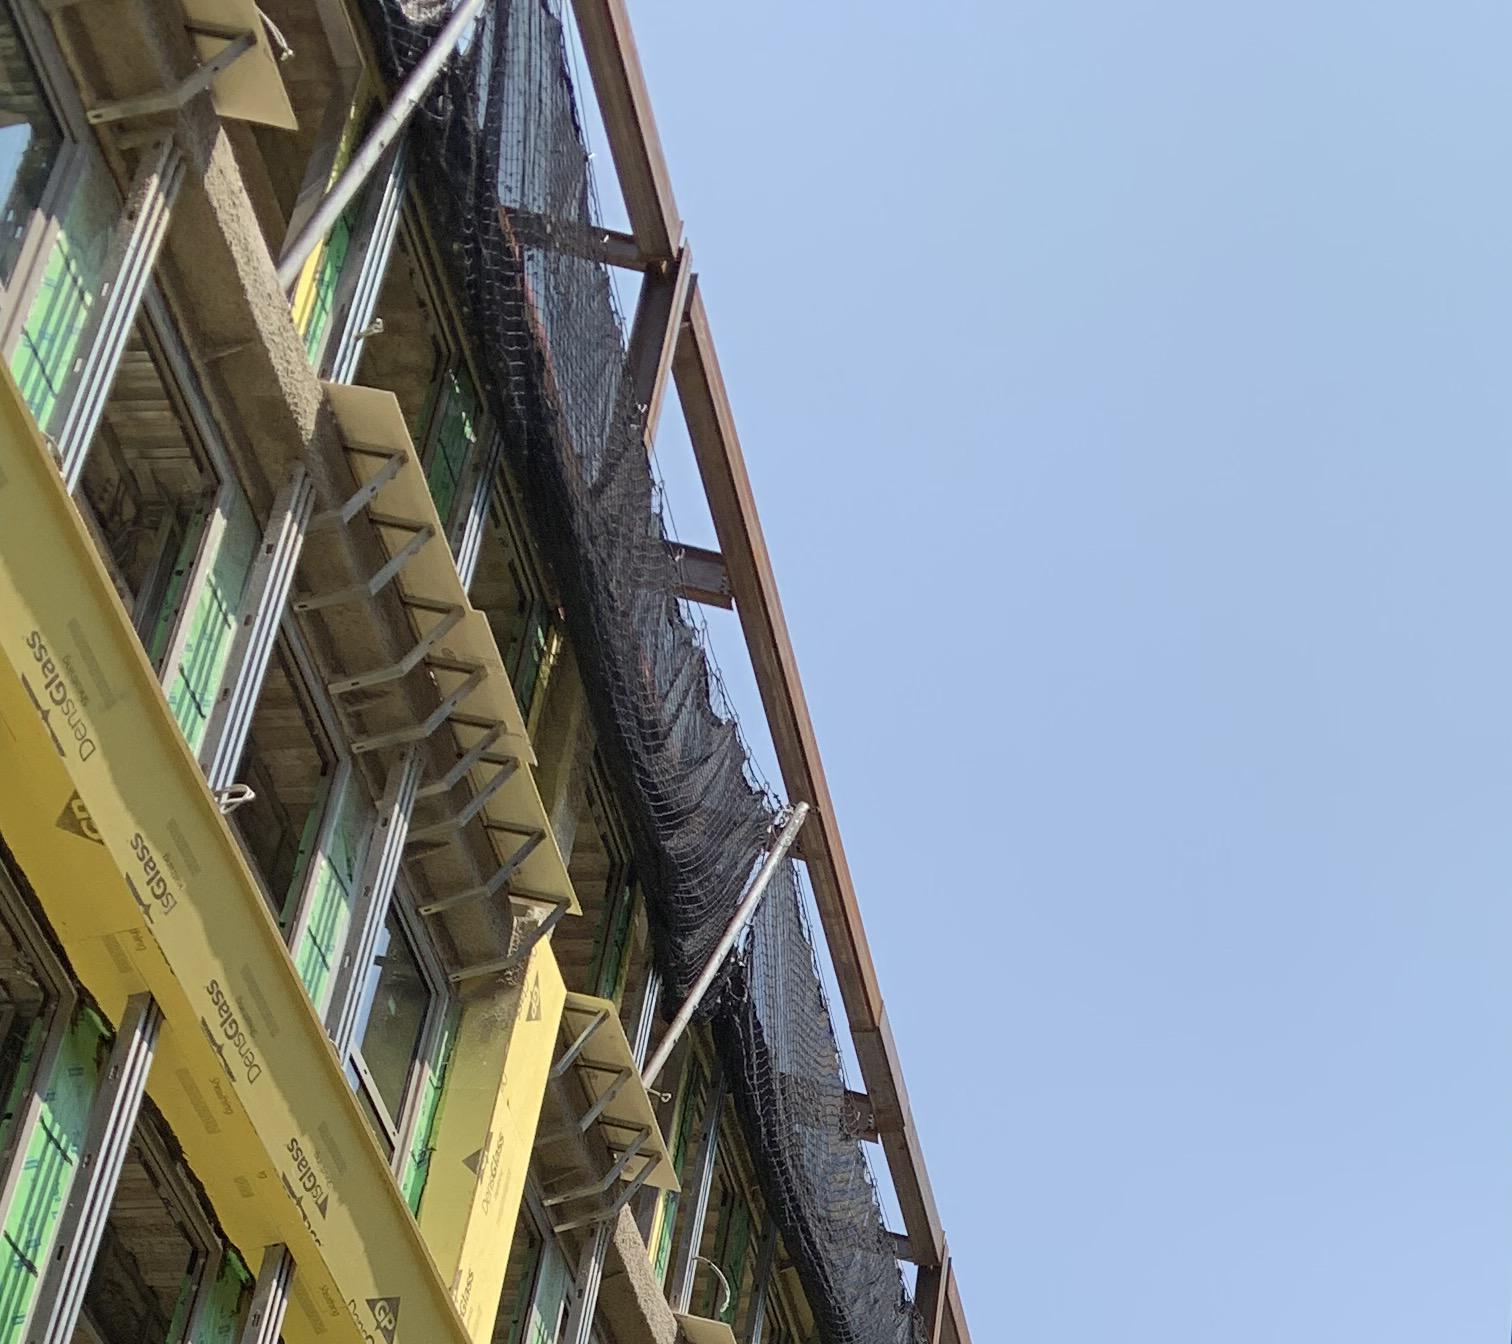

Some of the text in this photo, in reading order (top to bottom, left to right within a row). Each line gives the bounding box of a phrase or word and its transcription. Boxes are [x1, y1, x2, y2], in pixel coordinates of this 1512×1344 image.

[26, 630, 96, 762] DensGlass
[206, 979, 262, 1084] DensGlass
[374, 1300, 395, 1331] GP
